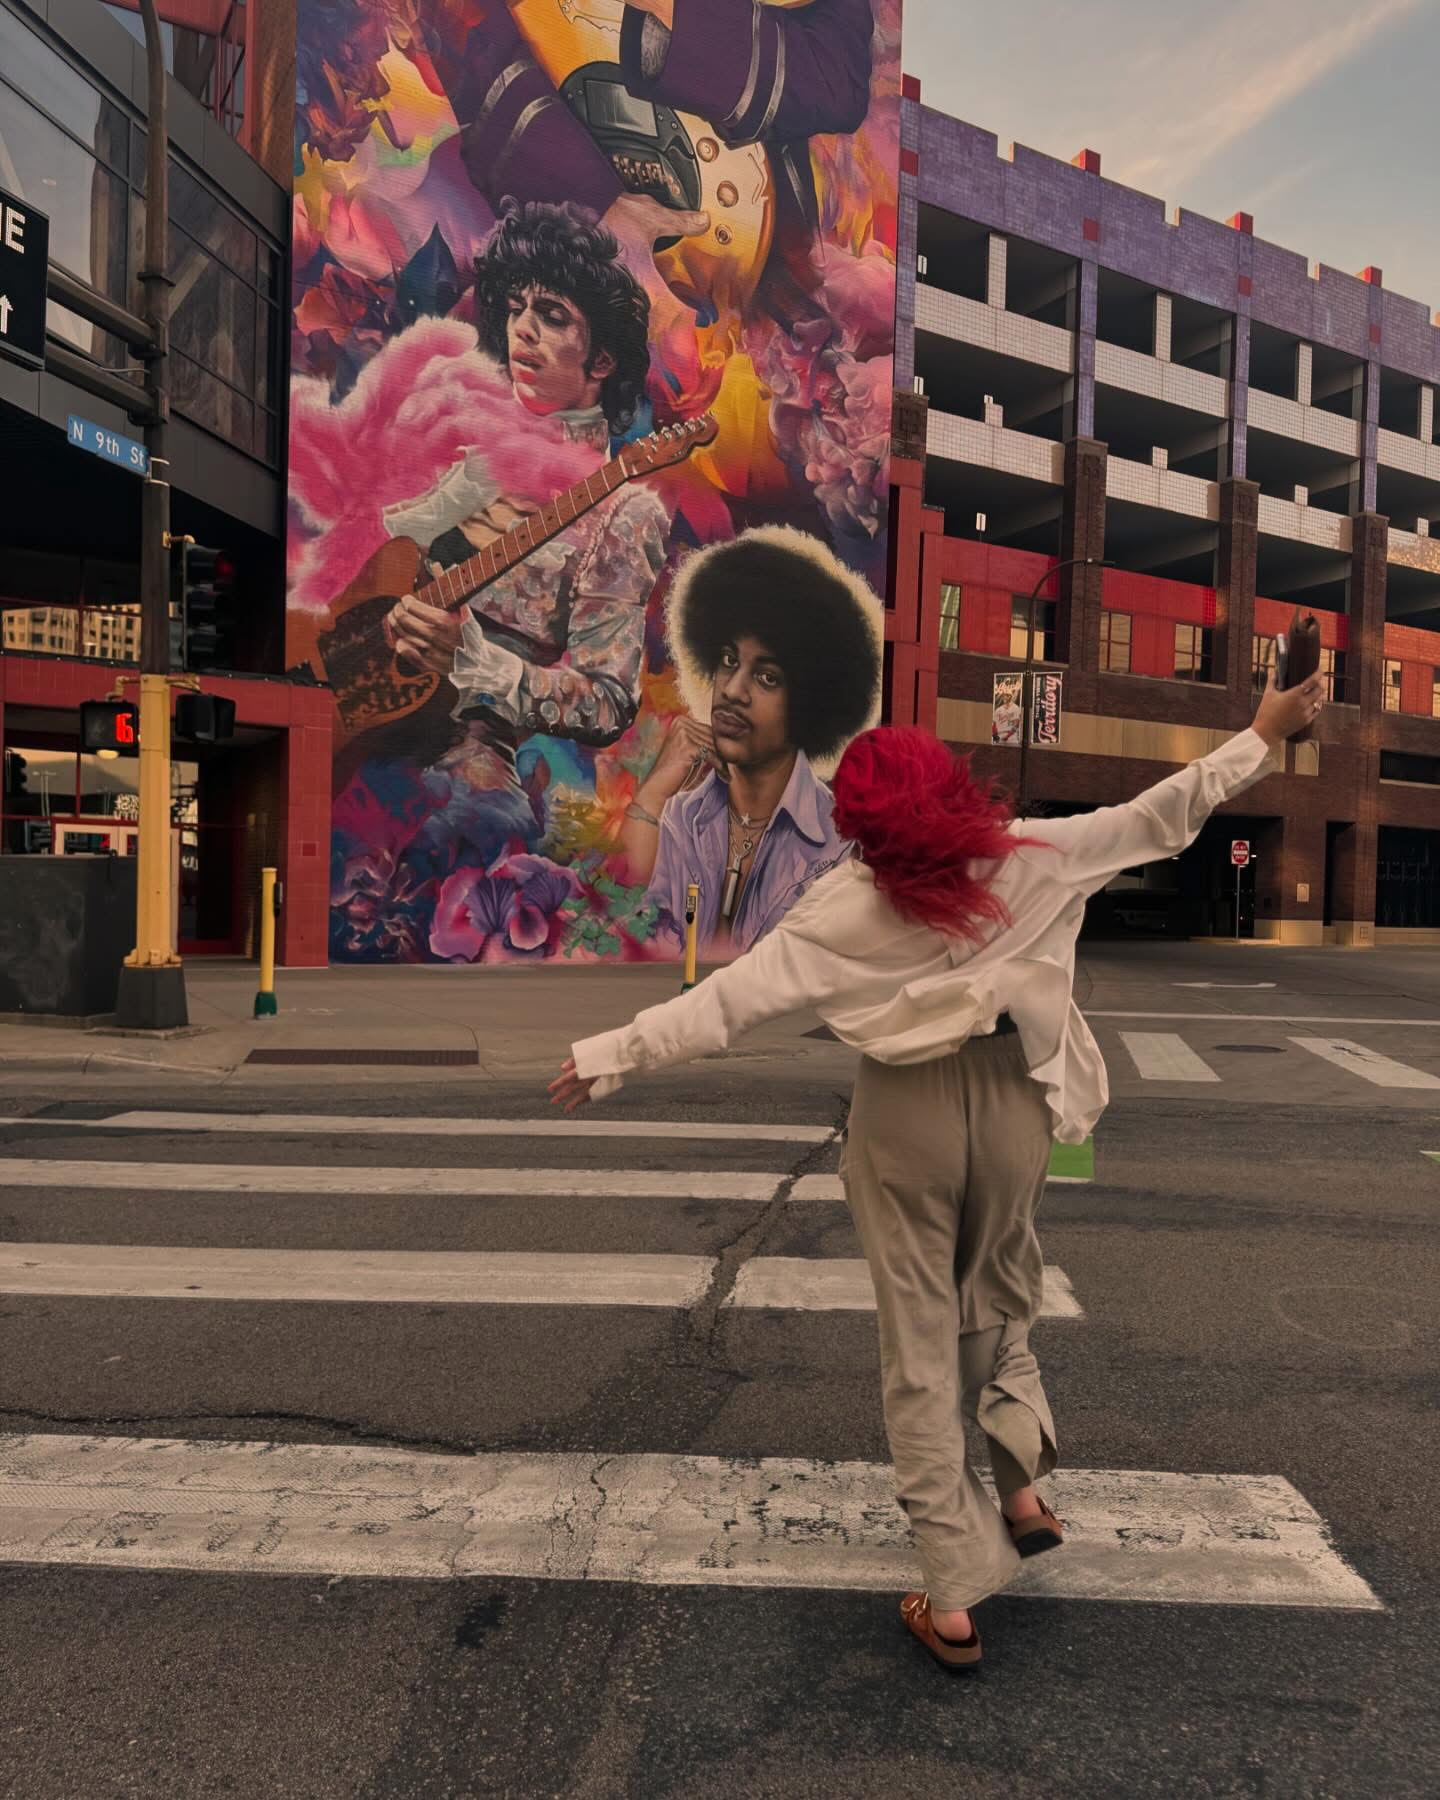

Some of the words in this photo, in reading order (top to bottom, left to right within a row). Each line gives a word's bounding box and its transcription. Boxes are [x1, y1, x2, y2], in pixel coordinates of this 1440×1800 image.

[73, 420, 83, 441] N
[95, 431, 120, 457] 9th
[130, 446, 145, 467] St
[115, 712, 134, 744] 6
[1038, 675, 1062, 743] Territory
